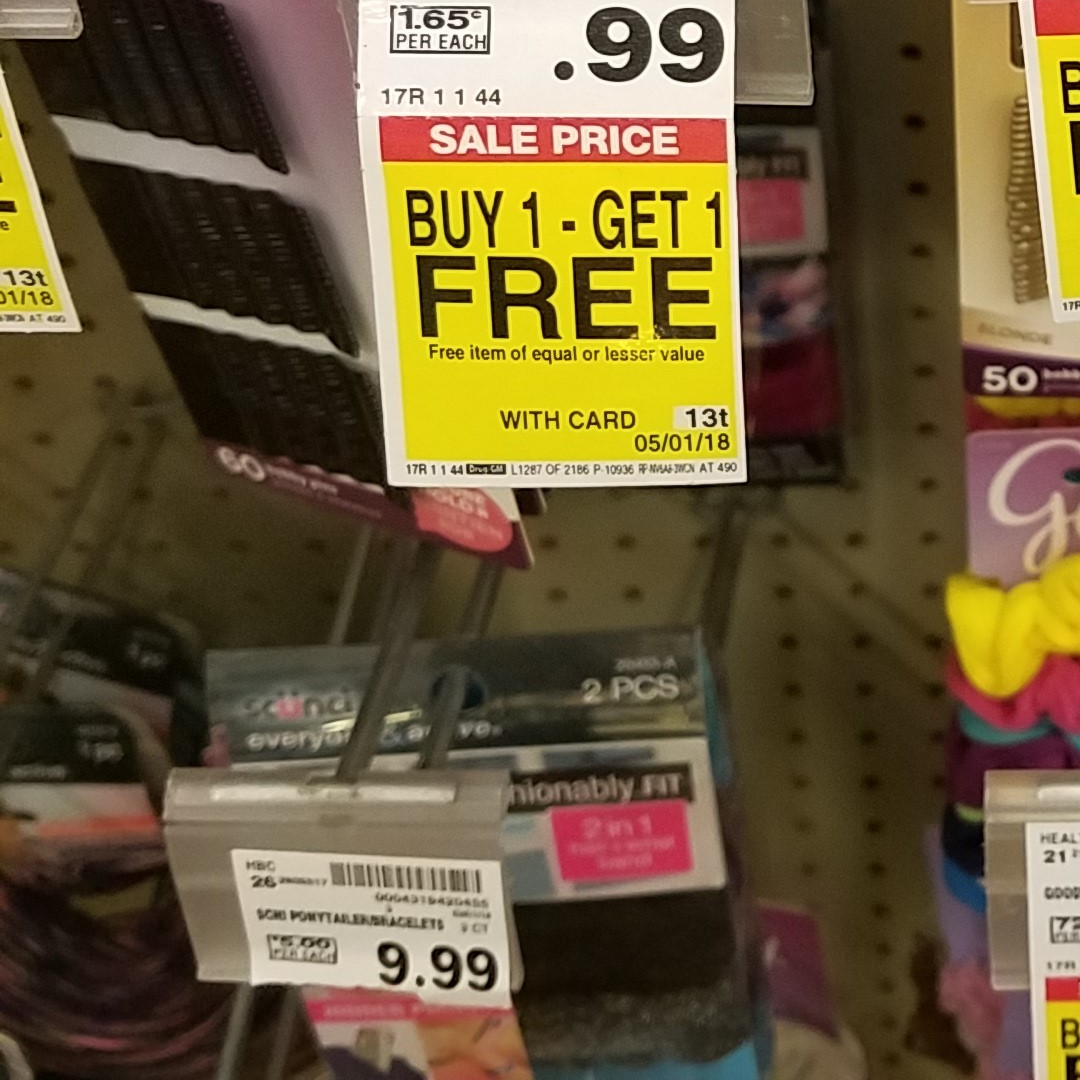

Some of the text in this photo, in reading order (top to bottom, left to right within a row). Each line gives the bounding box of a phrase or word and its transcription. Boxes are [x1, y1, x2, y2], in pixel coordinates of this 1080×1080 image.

[396, 33, 488, 50] PER EACH
[553, 6, 726, 84] .99
[380, 88, 501, 106] 17R 1 1 44
[428, 124, 680, 156] SALE PRICE
[406, 188, 723, 250] BUY 1 GET 1
[3, 270, 48, 287] 13t
[416, 254, 717, 340] FREE
[428, 344, 706, 365] Free item of equal or lesser value
[982, 364, 1039, 394] 50
[499, 410, 637, 431] WITH CARD
[685, 406, 730, 429] 13t
[634, 432, 731, 452] 05/01/18
[406, 464, 427, 476] 17R
[431, 464, 436, 476] 1
[441, 464, 446, 476] 1
[450, 464, 464, 476] 44
[511, 464, 542, 476] L1287
[546, 464, 560, 475] OF
[564, 464, 590, 476] 2186
[700, 462, 714, 473] AT
[718, 462, 738, 472] 490
[581, 674, 680, 702] 2 PCS
[1044, 850, 1066, 864] 21
[250, 875, 277, 896] 26
[376, 940, 499, 992] 9.99
